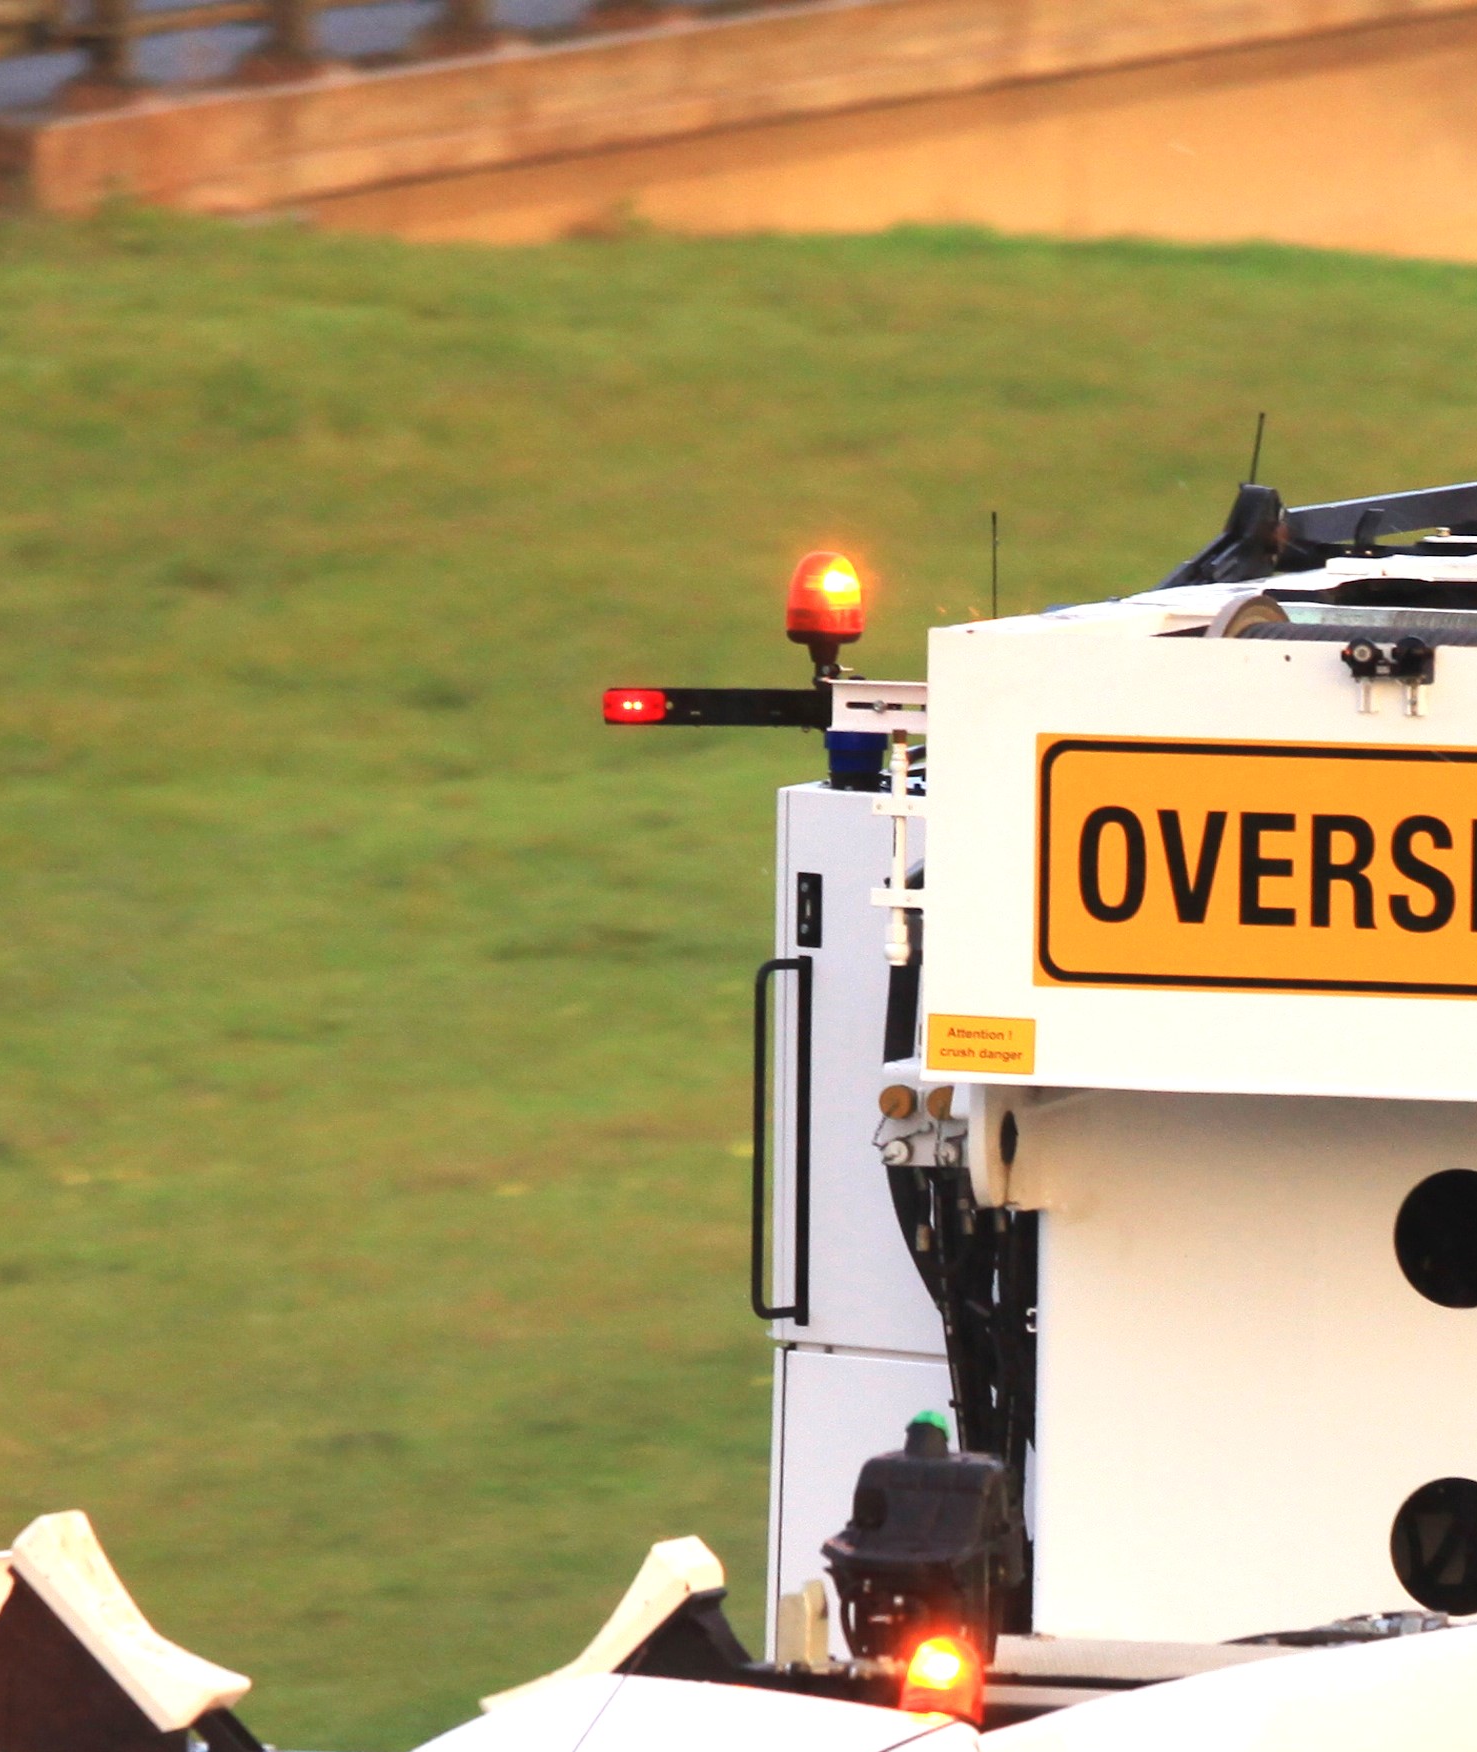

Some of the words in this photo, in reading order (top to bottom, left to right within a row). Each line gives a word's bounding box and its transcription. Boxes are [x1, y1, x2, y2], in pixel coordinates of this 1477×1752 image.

[947, 1027, 1005, 1041] Attention
[940, 1047, 975, 1058] crush
[979, 1048, 1023, 1062] danger
